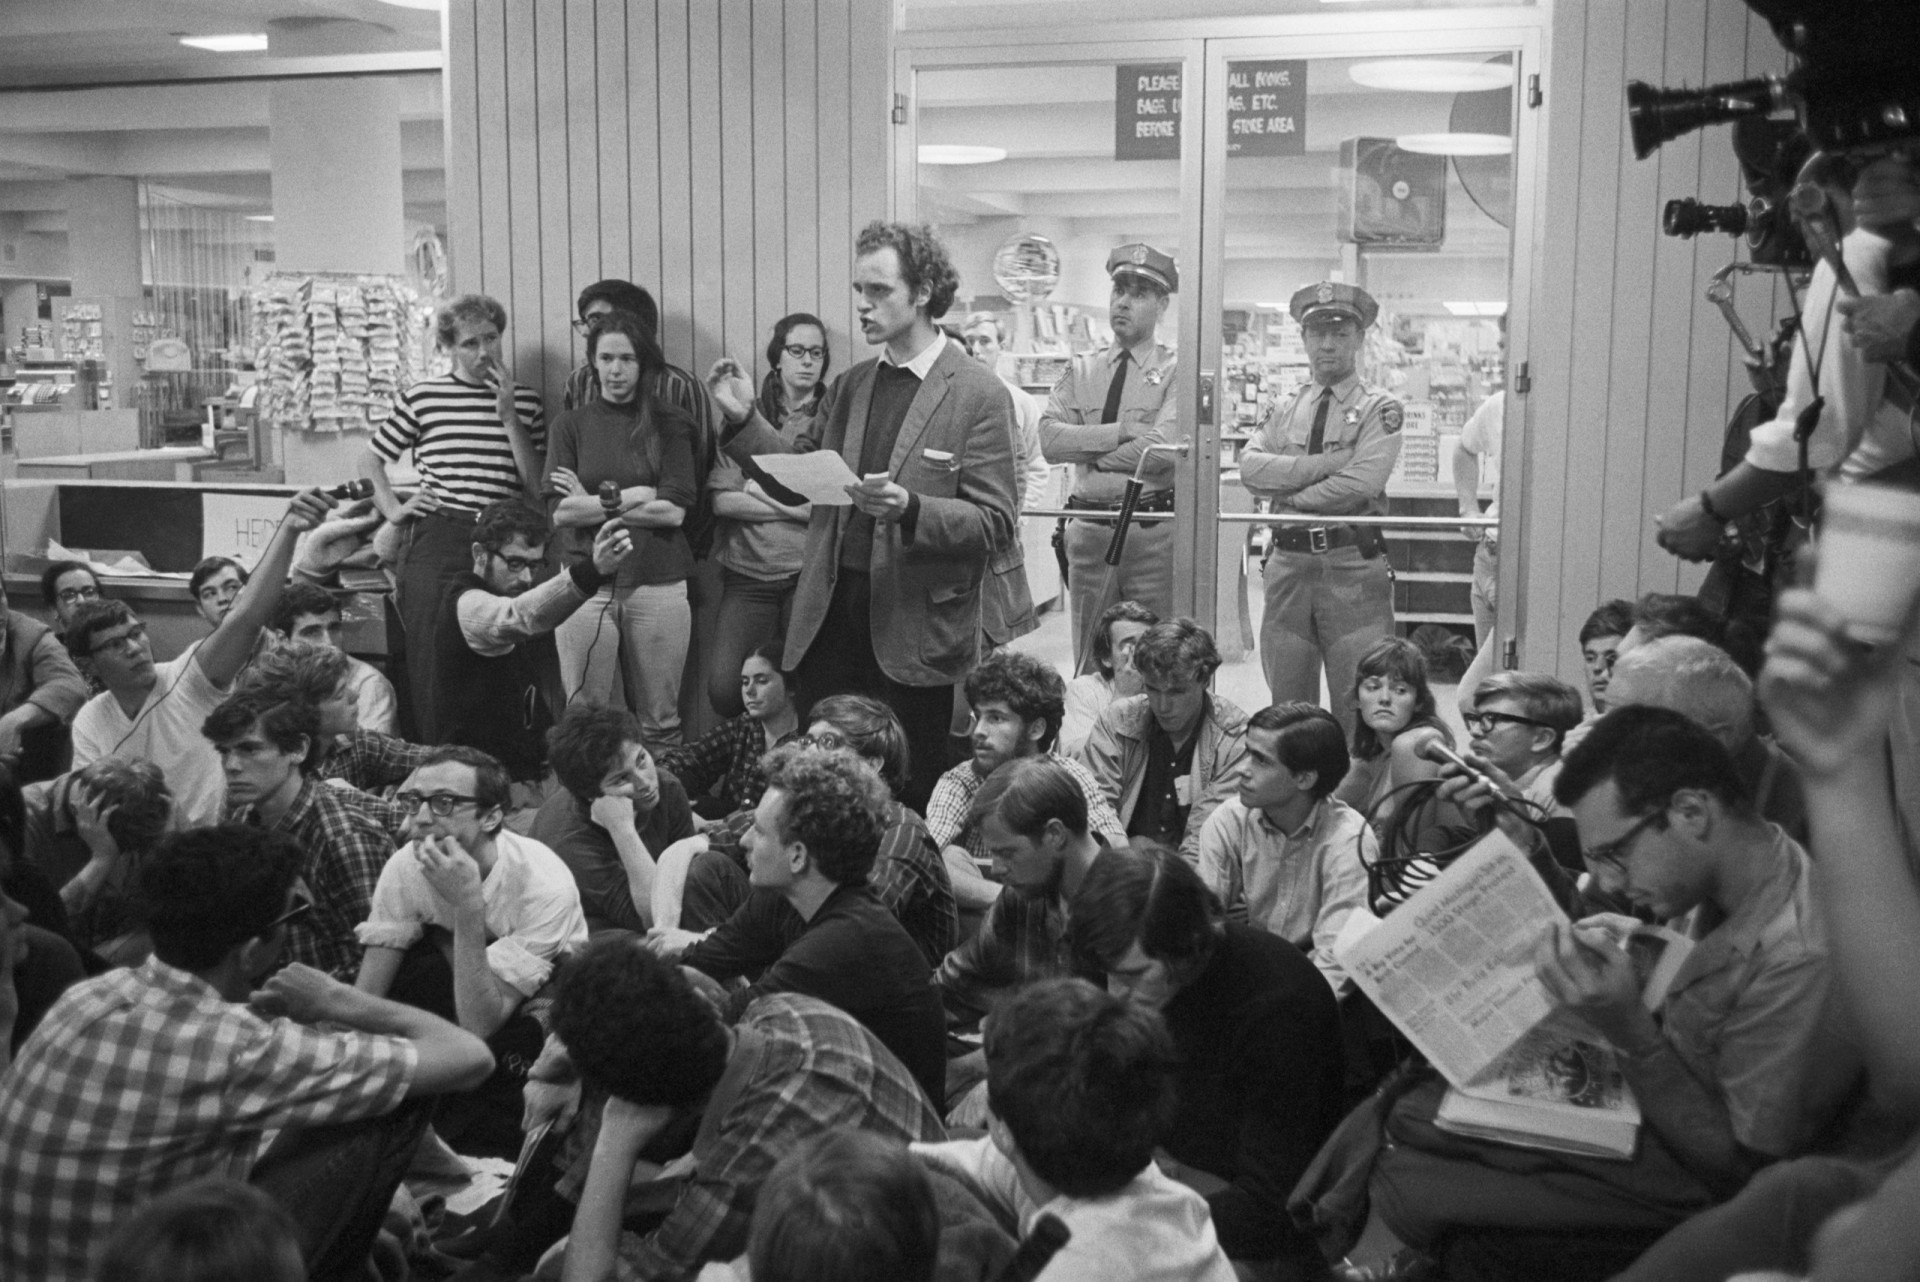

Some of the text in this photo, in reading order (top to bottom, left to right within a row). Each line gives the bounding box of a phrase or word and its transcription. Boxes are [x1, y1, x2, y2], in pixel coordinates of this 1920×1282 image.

[1138, 75, 1180, 92] PLEASE
[1229, 72, 1250, 88] ALL
[1252, 93, 1278, 111] ETC.
[1136, 116, 1295, 138] BEFORE STORE AREA
